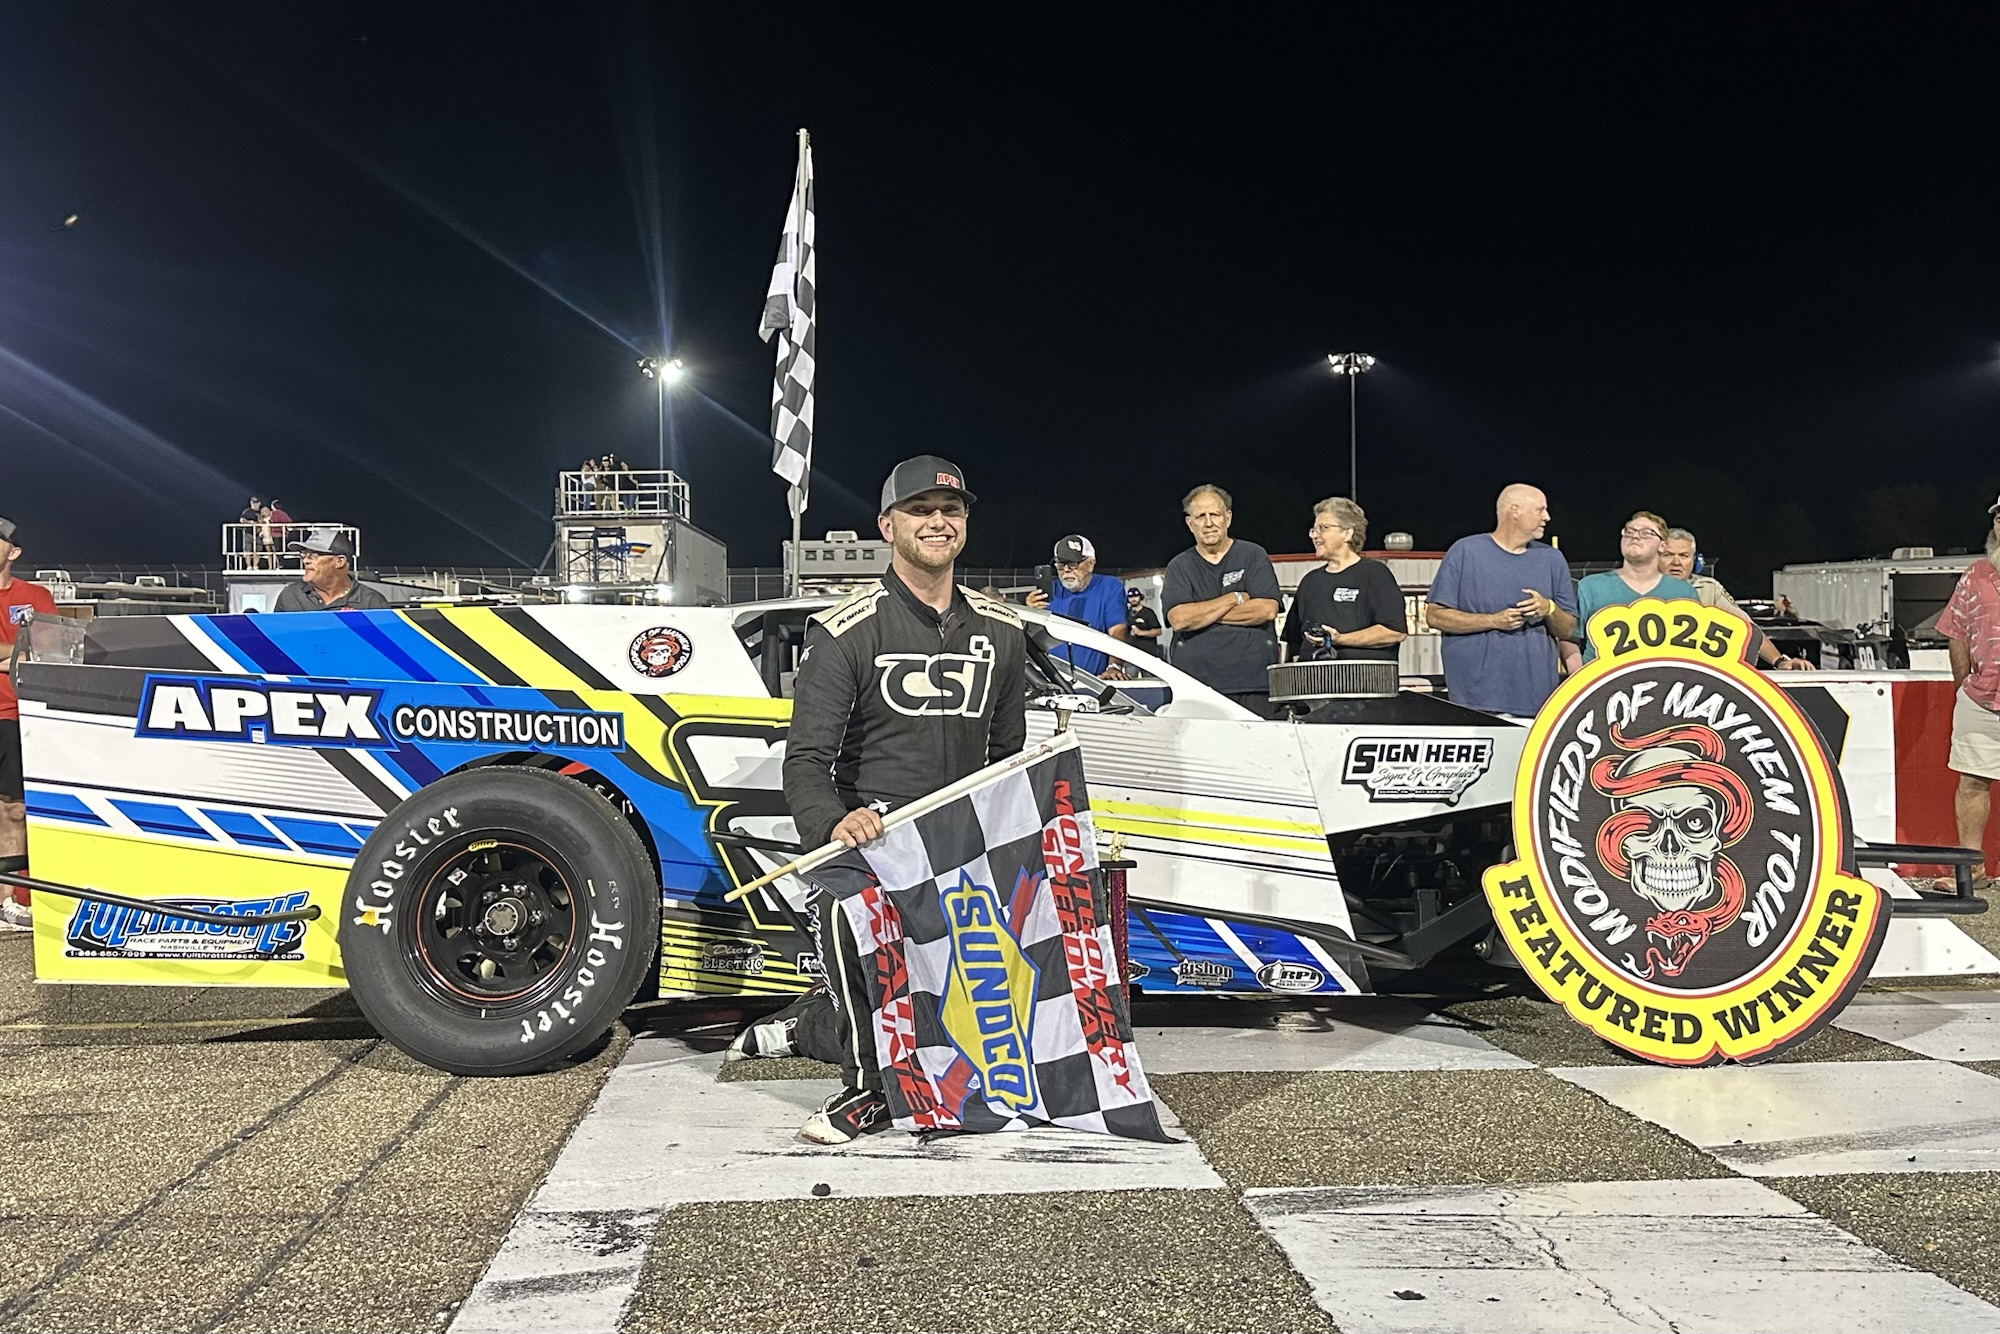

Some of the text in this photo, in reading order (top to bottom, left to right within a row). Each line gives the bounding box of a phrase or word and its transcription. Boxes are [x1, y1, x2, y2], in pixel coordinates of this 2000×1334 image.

[1603, 612, 1734, 659] 2025
[148, 685, 619, 746] APEX CONSTRUCTION
[1372, 766, 1475, 785] Signs & Graphics
[1425, 744, 1487, 763] HERE
[1548, 680, 1802, 948] MODIFIEDS OF MAYHEM TOUR
[353, 806, 463, 935] Hoosier
[702, 956, 764, 971] ELECTRIC
[713, 943, 754, 955] Dixon
[1042, 827, 1109, 1068] SPEEDWAY
[1179, 961, 1232, 978] Bishop
[1499, 874, 1863, 1045] FEATURED WINNER
[520, 910, 625, 1043] Hoosier
[950, 895, 1029, 1098] SUNOCO
[1281, 971, 1317, 980] RPI
